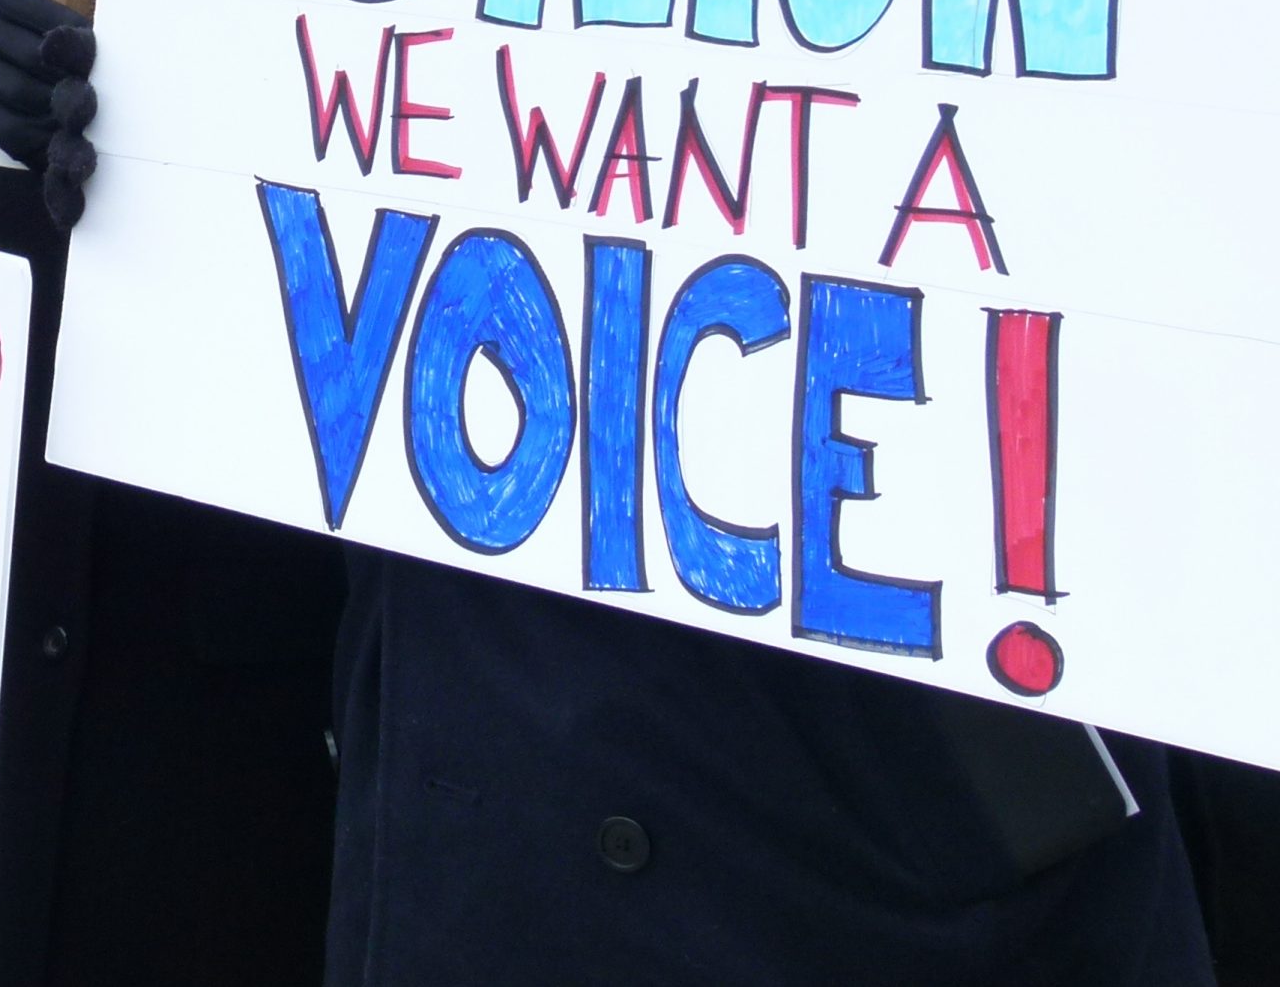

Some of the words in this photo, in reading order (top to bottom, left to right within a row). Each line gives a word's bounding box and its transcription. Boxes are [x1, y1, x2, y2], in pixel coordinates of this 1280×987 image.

[297, 14, 463, 179] WE
[497, 44, 862, 250] WANT
[878, 103, 1010, 275] A
[255, 175, 1069, 698] VOICE!
